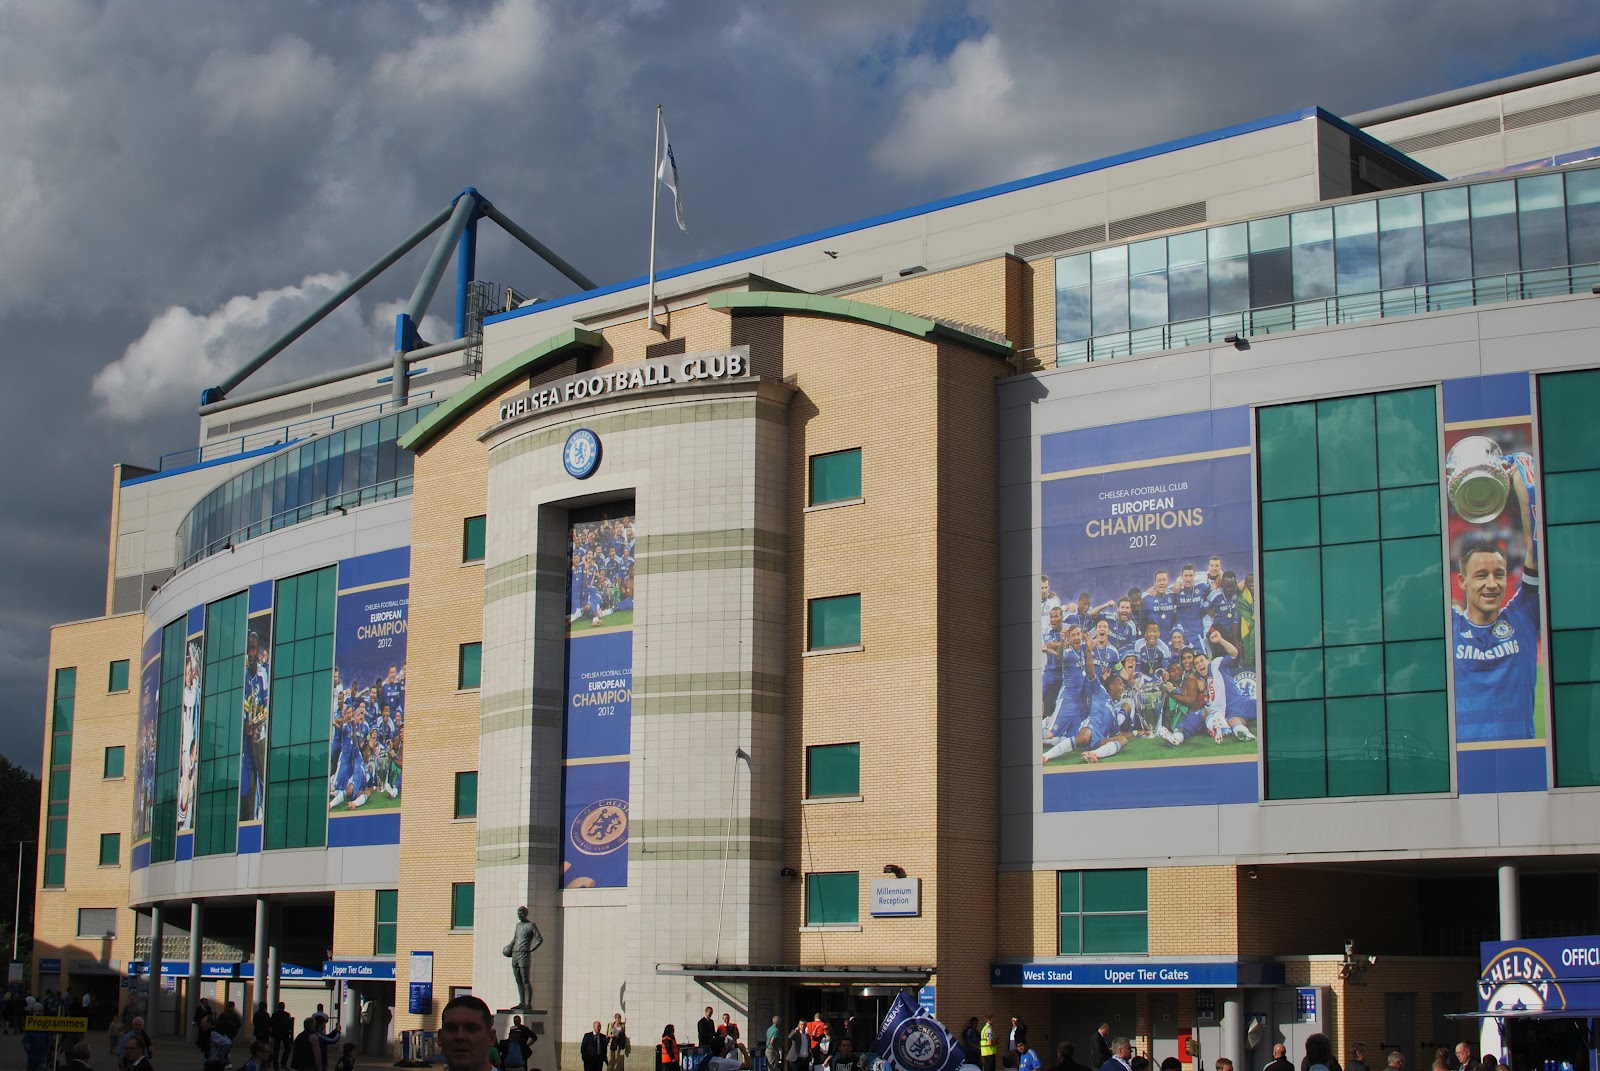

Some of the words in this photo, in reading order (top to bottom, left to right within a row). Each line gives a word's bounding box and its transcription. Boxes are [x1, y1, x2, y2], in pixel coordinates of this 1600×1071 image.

[499, 387, 561, 422] CHELSEA
[565, 363, 673, 401] FOOTBALL
[680, 354, 745, 382] CLUB
[1098, 489, 1130, 500] CHELSEA
[1130, 484, 1167, 496] FOOTBALL
[1168, 482, 1188, 492] CLUB
[1111, 497, 1174, 515] EUROPEAN
[1085, 508, 1204, 538] CHAMPIONS
[1129, 534, 1157, 549] 2012
[364, 603, 381, 611] CHELSEA
[380, 600, 399, 608] FOOTBALL
[370, 609, 402, 623] EUROPEAN
[377, 637, 393, 649] 2012
[1455, 639, 1520, 660] SAMSUNG
[581, 671, 600, 679] CHELSEA
[600, 669, 622, 677] FOOTBALL
[588, 678, 626, 691] EUROPEAN
[598, 706, 615, 716] 2012
[876, 887, 912, 896] Millennium
[878, 897, 909, 906] Reception
[210, 966, 220, 974] West
[220, 966, 232, 974] Stand
[281, 967, 290, 975] Tier
[290, 967, 304, 975] Gates
[332, 965, 347, 975] Upper
[348, 965, 358, 974] Tier
[358, 965, 373, 974] Gates
[1023, 970, 1046, 981] West
[1047, 970, 1073, 981] Stand
[1104, 969, 1136, 983] Upper
[1137, 968, 1157, 980] Tier
[1159, 968, 1189, 980] Gates
[1478, 955, 1549, 1002] CHELSEA
[27, 1017, 85, 1030] Programmes
[917, 1026, 940, 1048] CHELSEA
[901, 1045, 913, 1062] FOOTBALL
